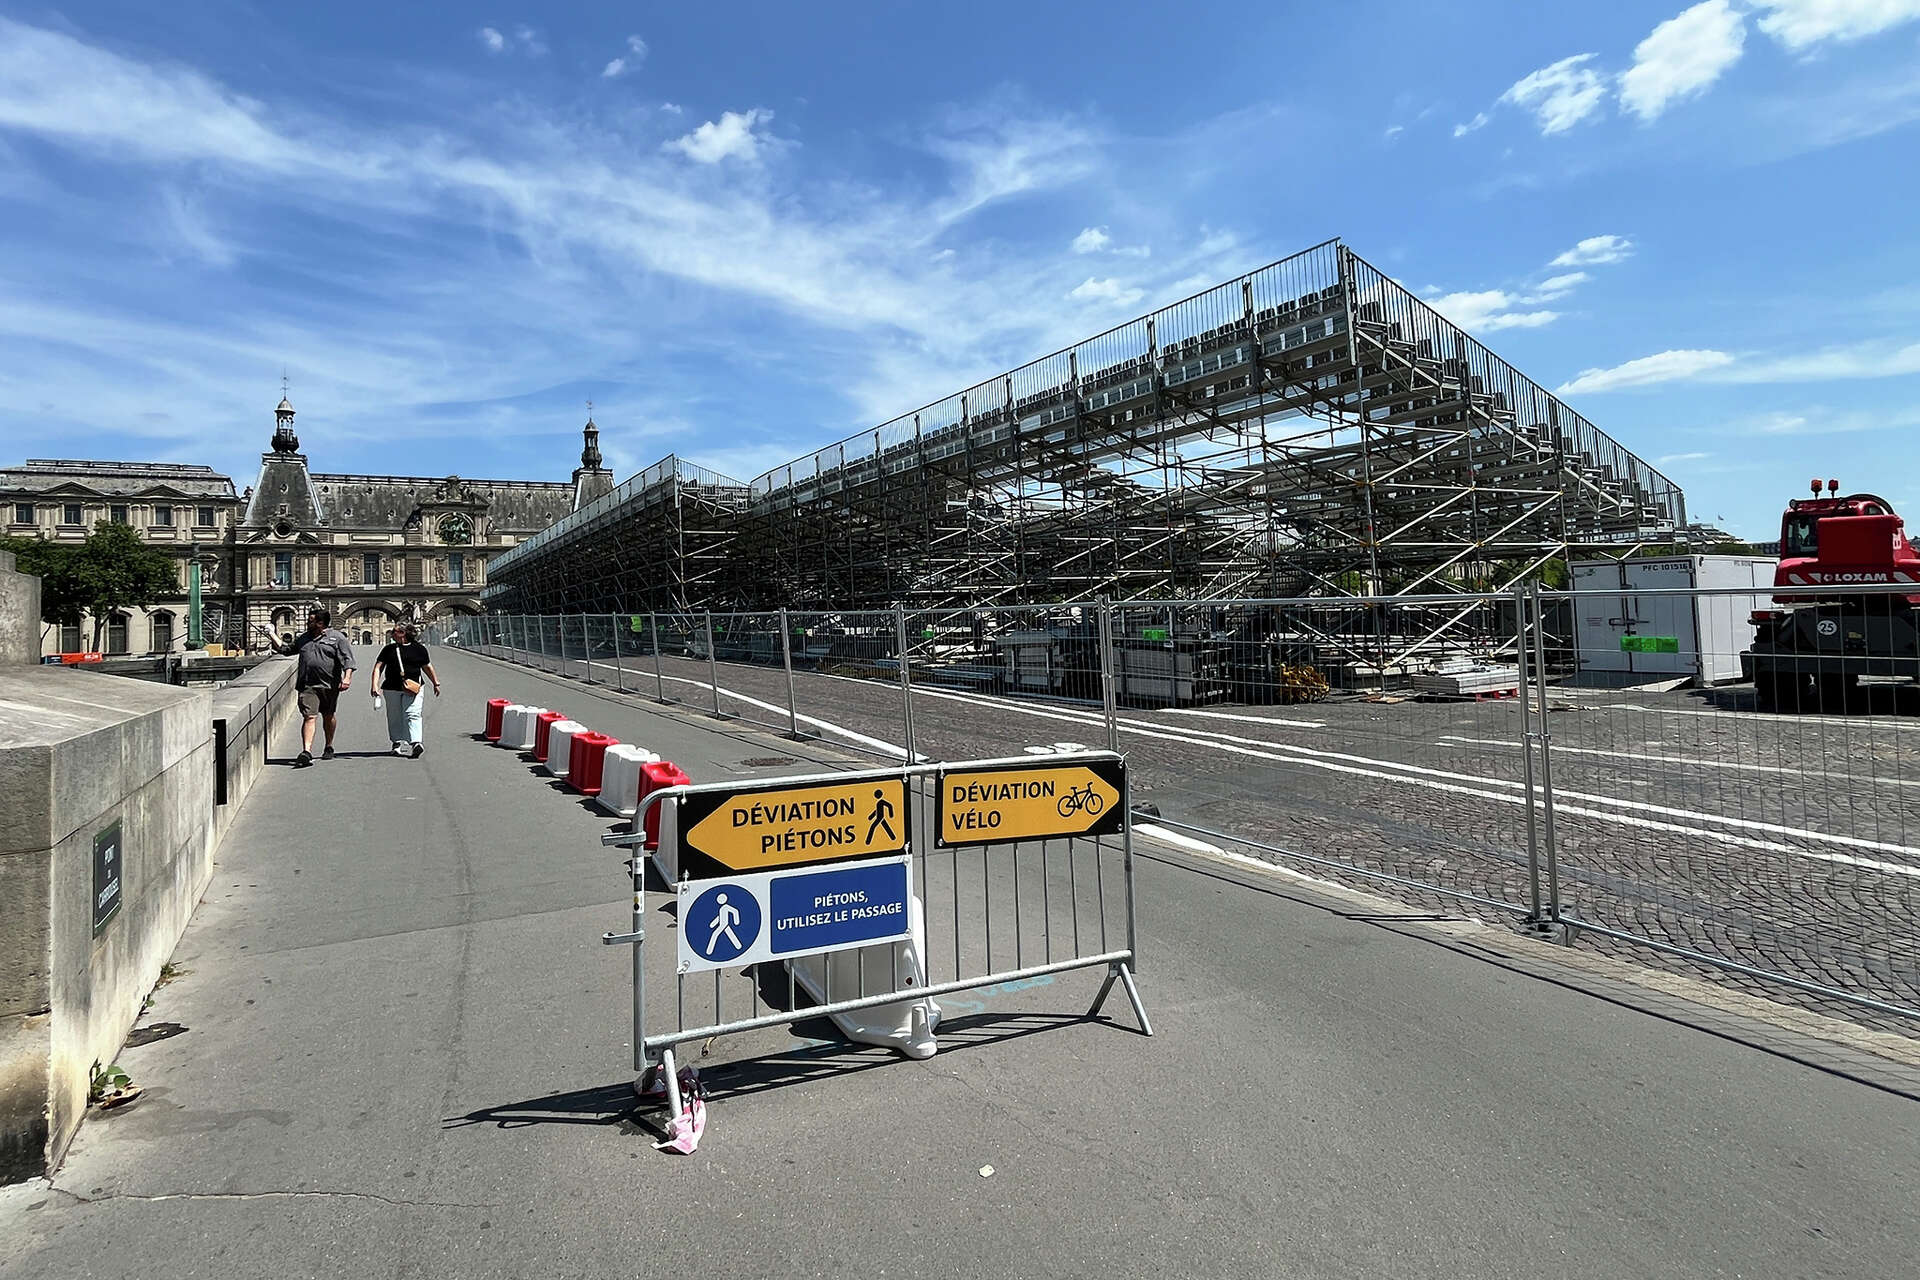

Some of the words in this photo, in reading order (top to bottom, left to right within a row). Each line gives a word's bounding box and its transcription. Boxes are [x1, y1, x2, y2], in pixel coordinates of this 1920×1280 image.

[1835, 573, 1888, 582] LOXAM
[1819, 623, 1834, 632] 25
[952, 780, 1055, 803] DÉVIATION
[732, 797, 855, 828] DÉVIATION
[951, 808, 1001, 830] VÉLO
[761, 825, 856, 853] PIÉTONS
[814, 891, 868, 908] PIÉTONS,
[777, 912, 831, 931] UTILISEZ
[834, 910, 848, 922] LE
[851, 902, 902, 919] PASSAGE
